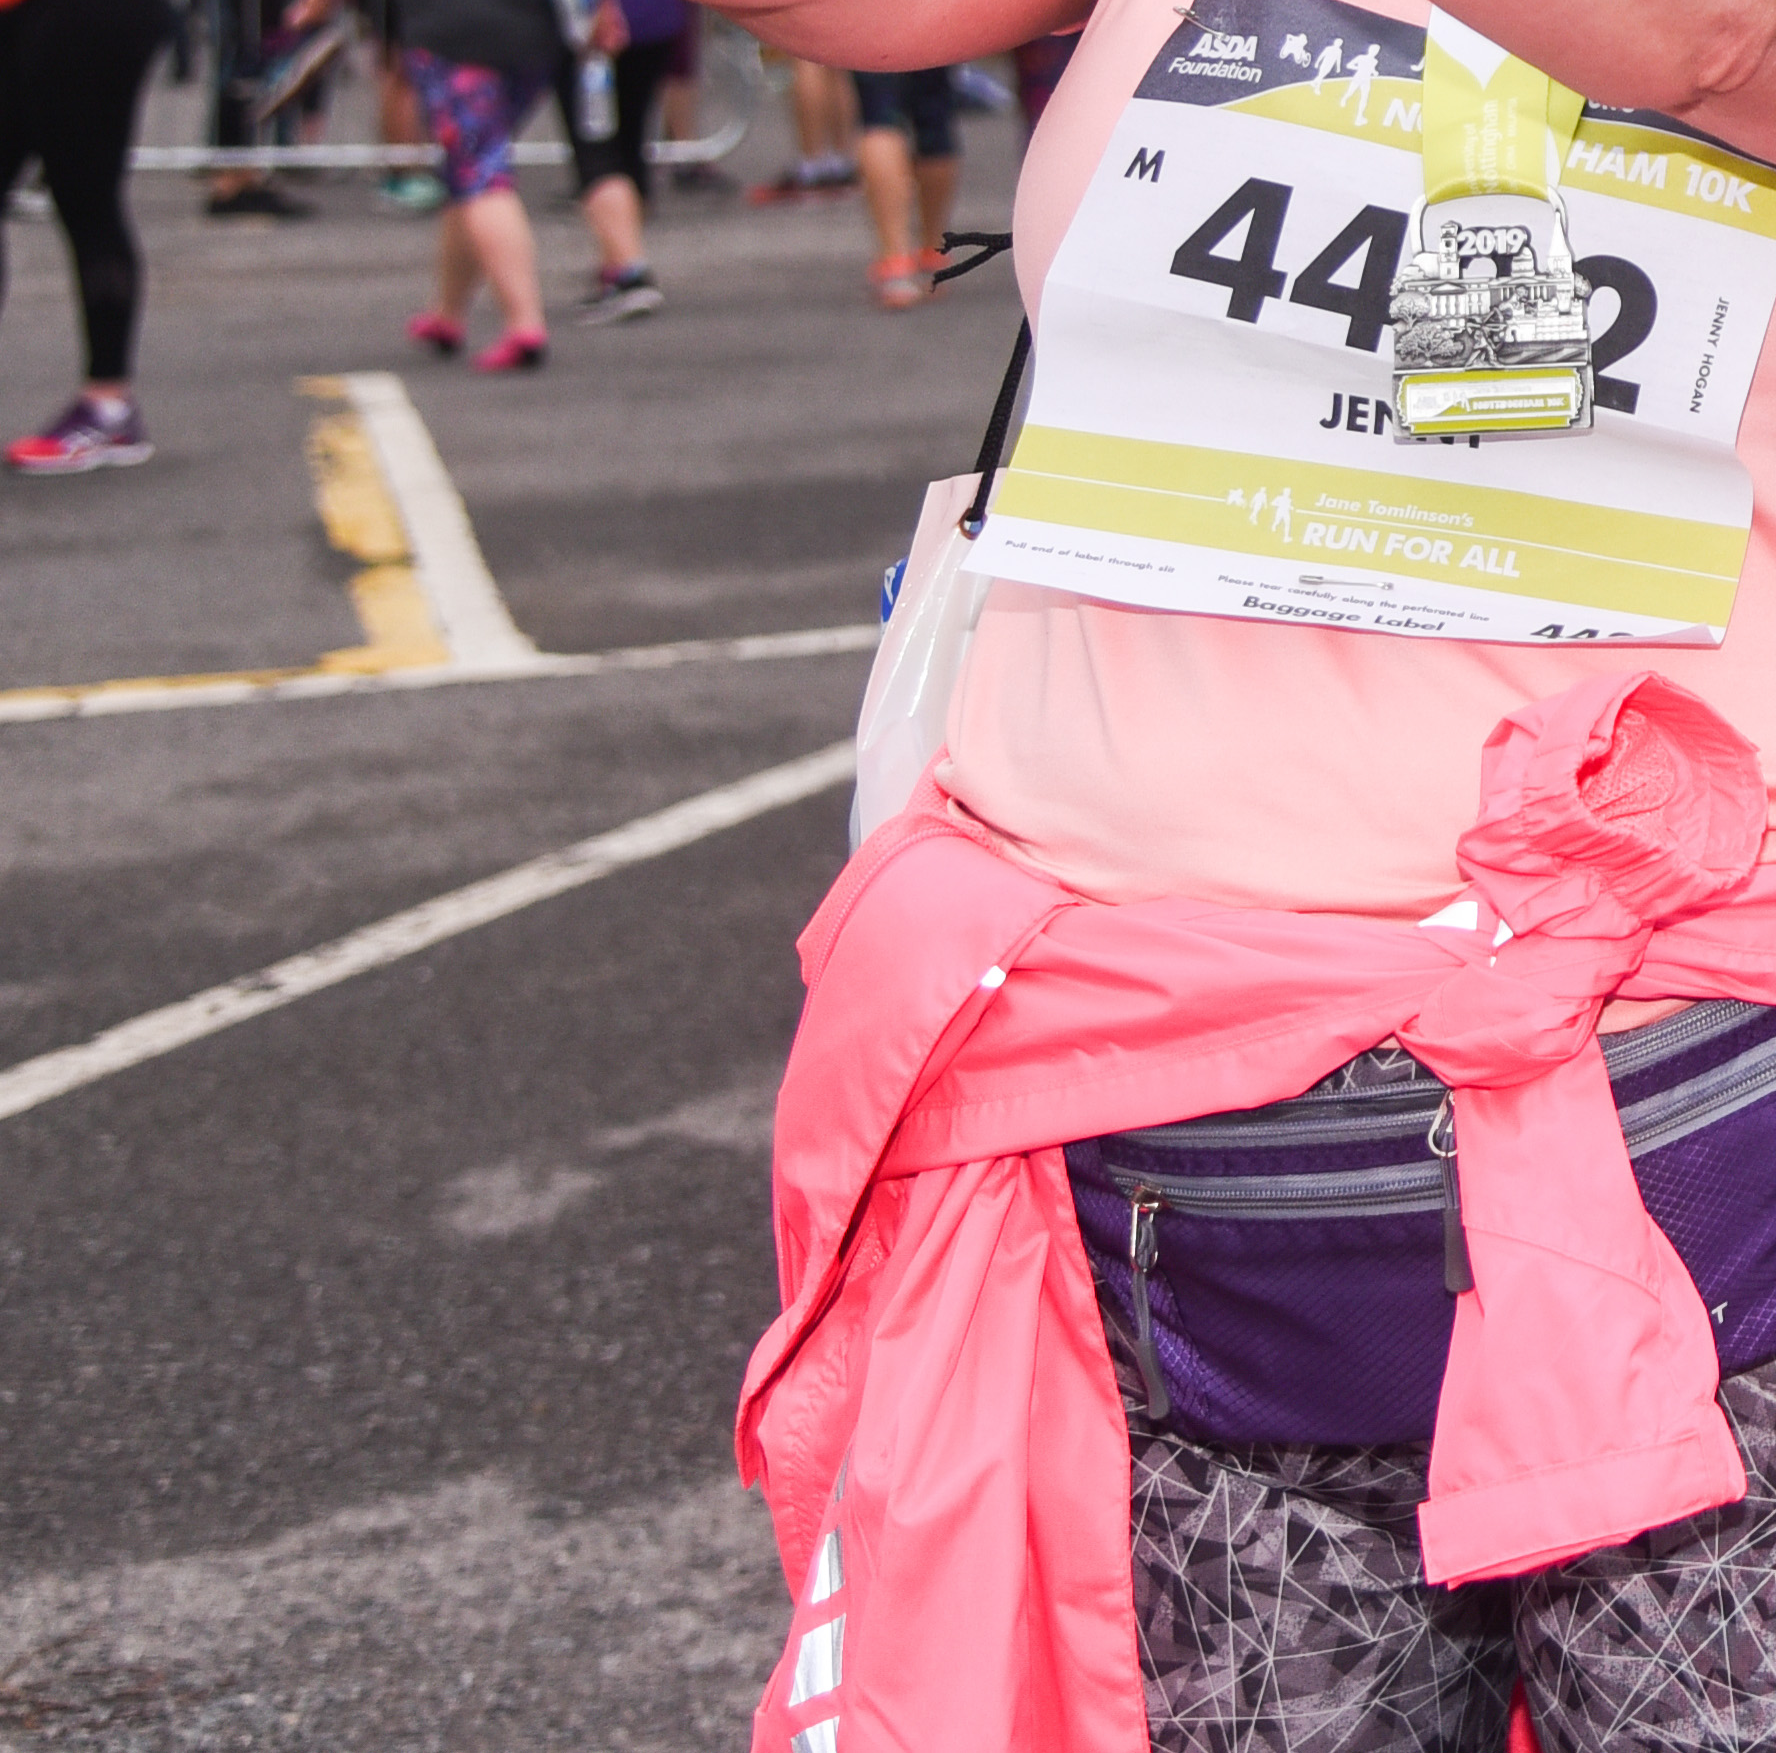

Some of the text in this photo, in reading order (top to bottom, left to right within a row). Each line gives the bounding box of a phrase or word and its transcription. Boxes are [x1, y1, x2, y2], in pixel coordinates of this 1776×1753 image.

[1189, 32, 1258, 62] ASDA
[1168, 57, 1262, 84] Foundation
[1124, 147, 1166, 183] M
[1479, 99, 1503, 192] Nottingham
[1686, 164, 1758, 213] 10K
[1459, 228, 1528, 256] 2019
[1169, 177, 1658, 415] 442
[1689, 297, 1730, 414] JENNY HOGAN
[1319, 392, 1480, 449] JEN
[1315, 493, 1475, 527] Jane Tomlinson's
[1005, 540, 1027, 550] Pull
[1031, 545, 1054, 554] end
[1058, 549, 1070, 557] of
[1075, 551, 1103, 562] label
[1108, 557, 1153, 571] through
[1303, 522, 1520, 578] RUN FOR ALL
[1218, 574, 1490, 622] Please tear carefully along the perforated line
[1243, 596, 1445, 632] Baggage Label
